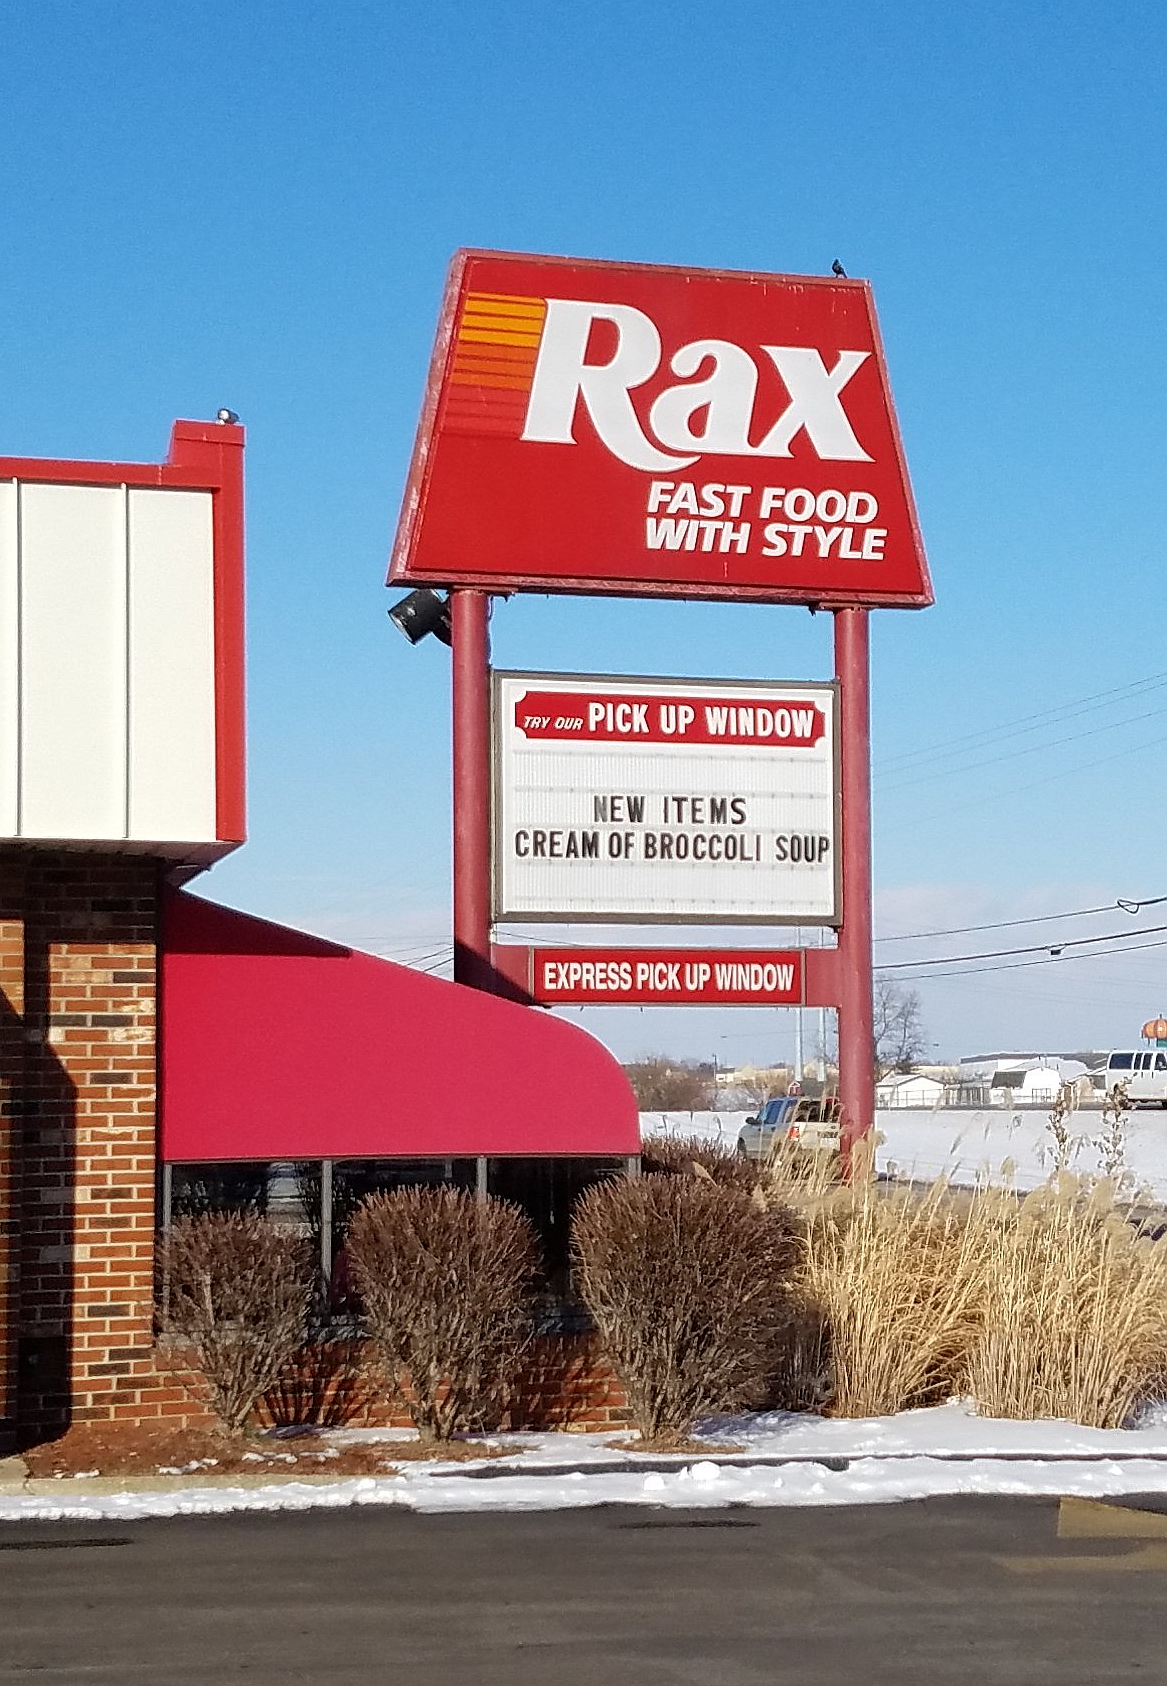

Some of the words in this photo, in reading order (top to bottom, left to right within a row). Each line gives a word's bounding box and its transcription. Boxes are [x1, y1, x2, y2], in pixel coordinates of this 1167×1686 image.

[520, 297, 876, 473] Rax
[647, 481, 751, 519] FAST
[759, 487, 878, 524] FOOD
[646, 518, 751, 553] WITH
[761, 525, 887, 560] STYLE
[523, 716, 551, 729] TRY
[555, 717, 583, 731] OUR
[589, 702, 649, 733] PICK
[660, 704, 695, 734] UP
[705, 706, 814, 739] WINDOW
[594, 795, 646, 823] NEW
[663, 796, 746, 824] ITEMS
[515, 830, 599, 859] CREAM
[609, 832, 635, 859] OF
[644, 832, 761, 862] BROCCOLI
[775, 835, 830, 863] SOUP
[544, 962, 633, 990] EXPRESS
[636, 963, 681, 990] PICK
[685, 963, 711, 991] UP
[715, 963, 794, 992] WINDOW
